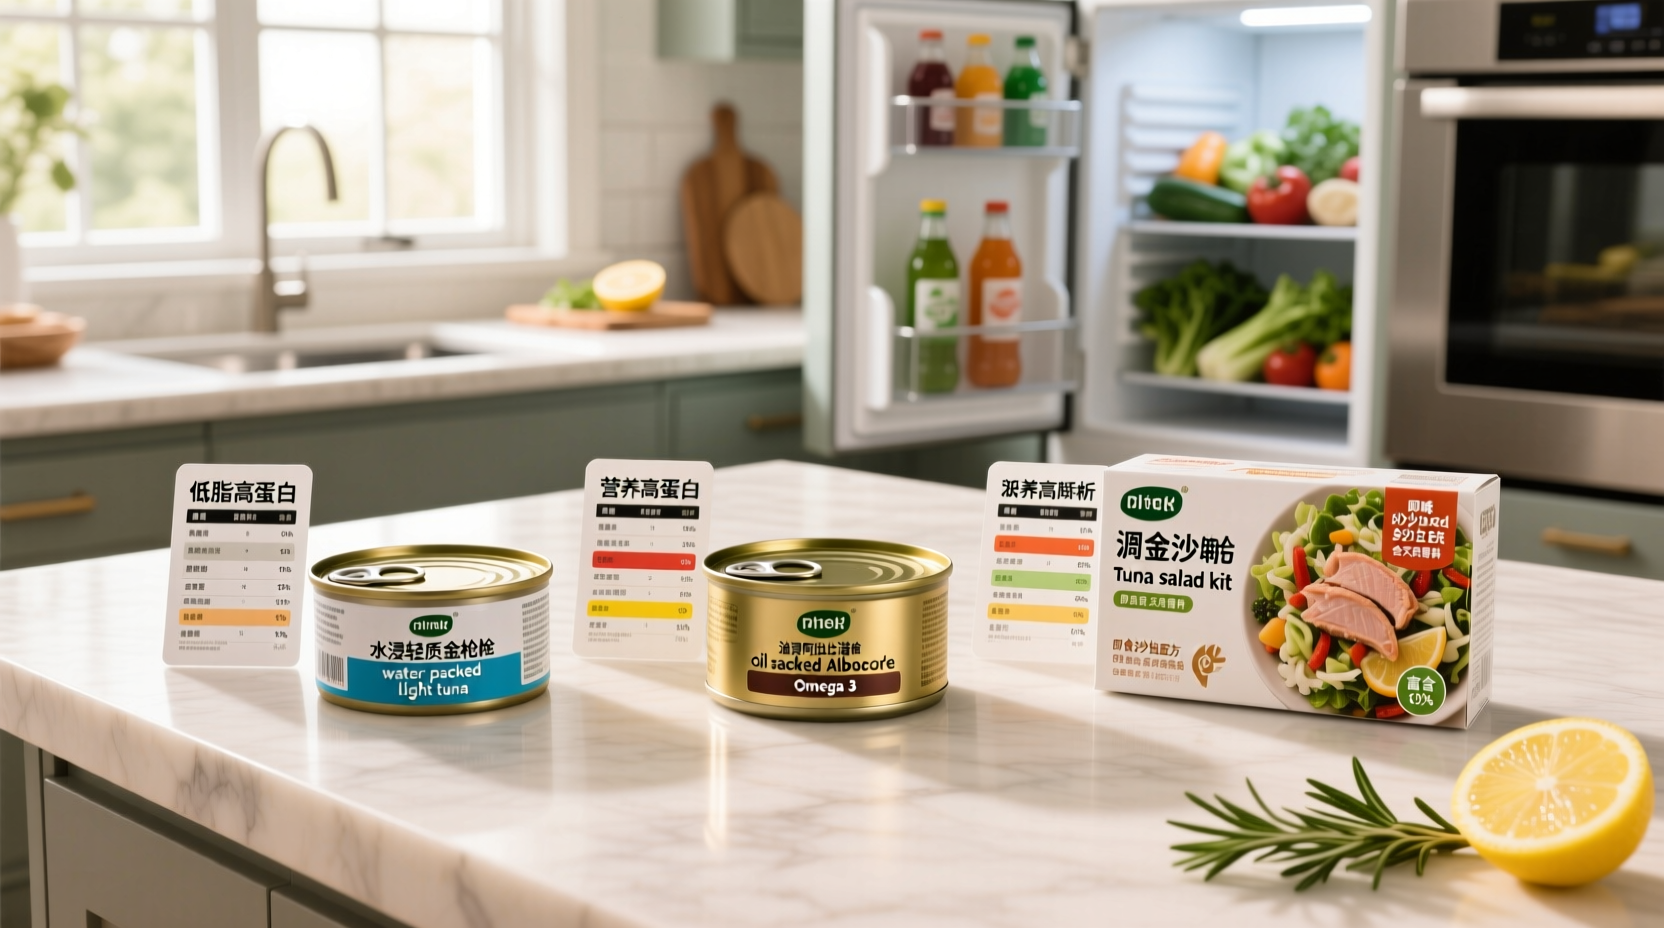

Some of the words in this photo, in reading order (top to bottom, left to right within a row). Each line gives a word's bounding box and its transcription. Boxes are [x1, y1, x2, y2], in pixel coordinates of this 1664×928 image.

[190, 480, 296, 504] 低脂高蛋白
[600, 476, 699, 499] 营养高蛋白
[1113, 566, 1154, 585] Tuna
[1159, 569, 1204, 589] salad
[1210, 571, 1233, 591] kit
[751, 653, 767, 669] oil
[382, 667, 426, 680] water
[429, 662, 482, 683] packed
[398, 682, 432, 701] light
[436, 684, 469, 696] tuna
[794, 678, 844, 696] Omega
[848, 679, 857, 692] 3
